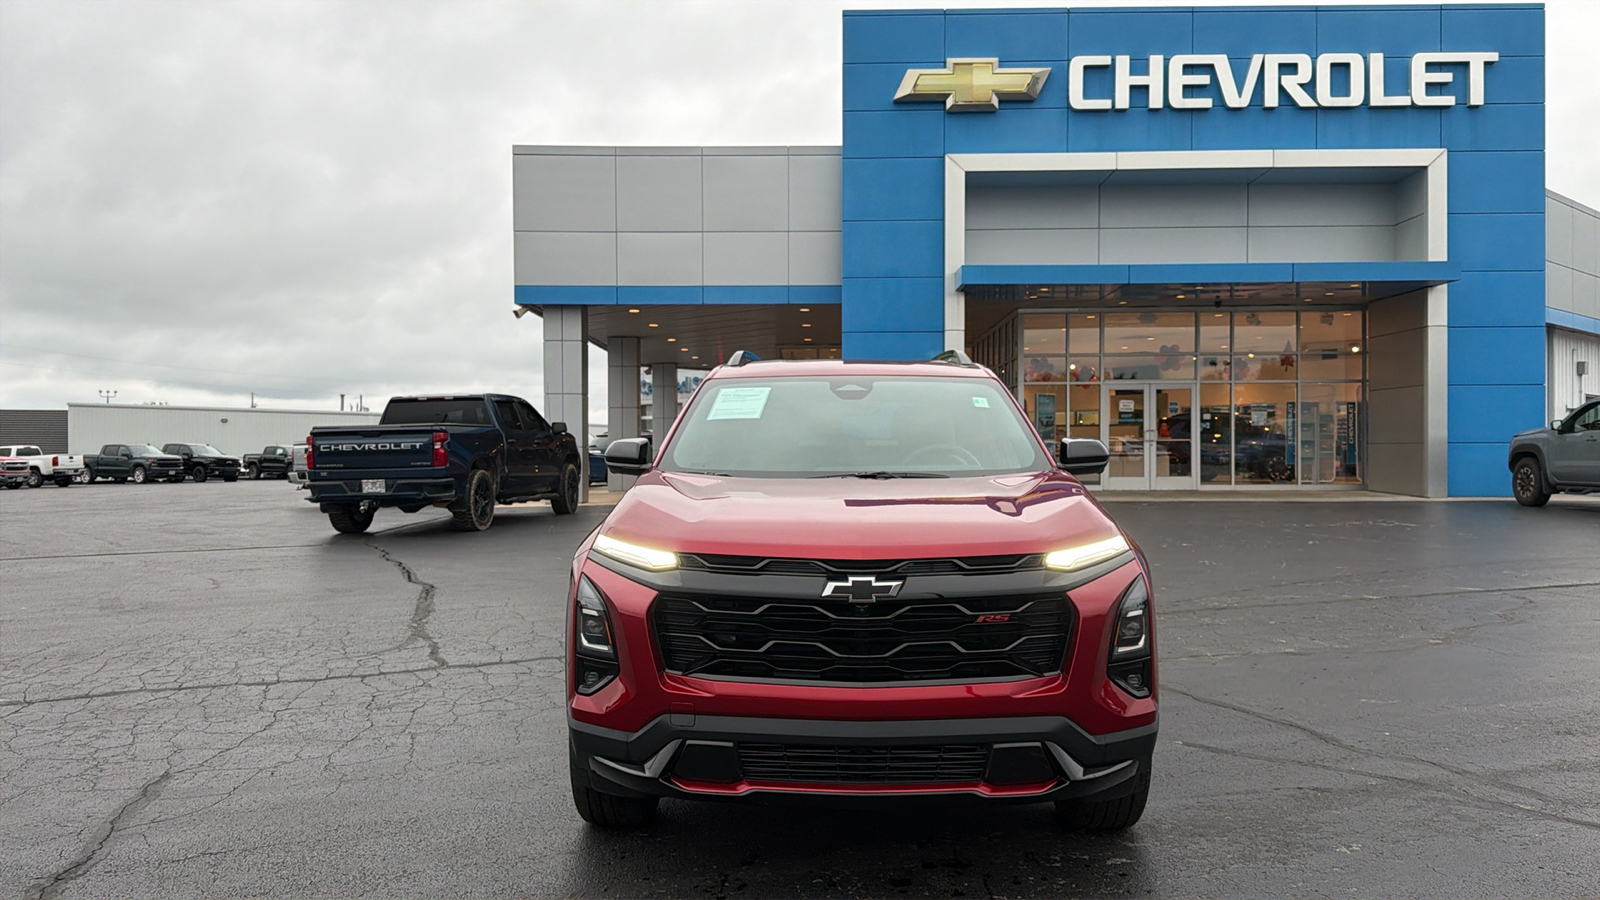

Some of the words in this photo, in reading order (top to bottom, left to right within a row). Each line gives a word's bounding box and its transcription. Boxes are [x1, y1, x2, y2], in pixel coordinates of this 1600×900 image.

[1068, 51, 1500, 110] CHEVROLET
[320, 442, 424, 452] CHEVROLET
[976, 614, 1010, 623] RS
